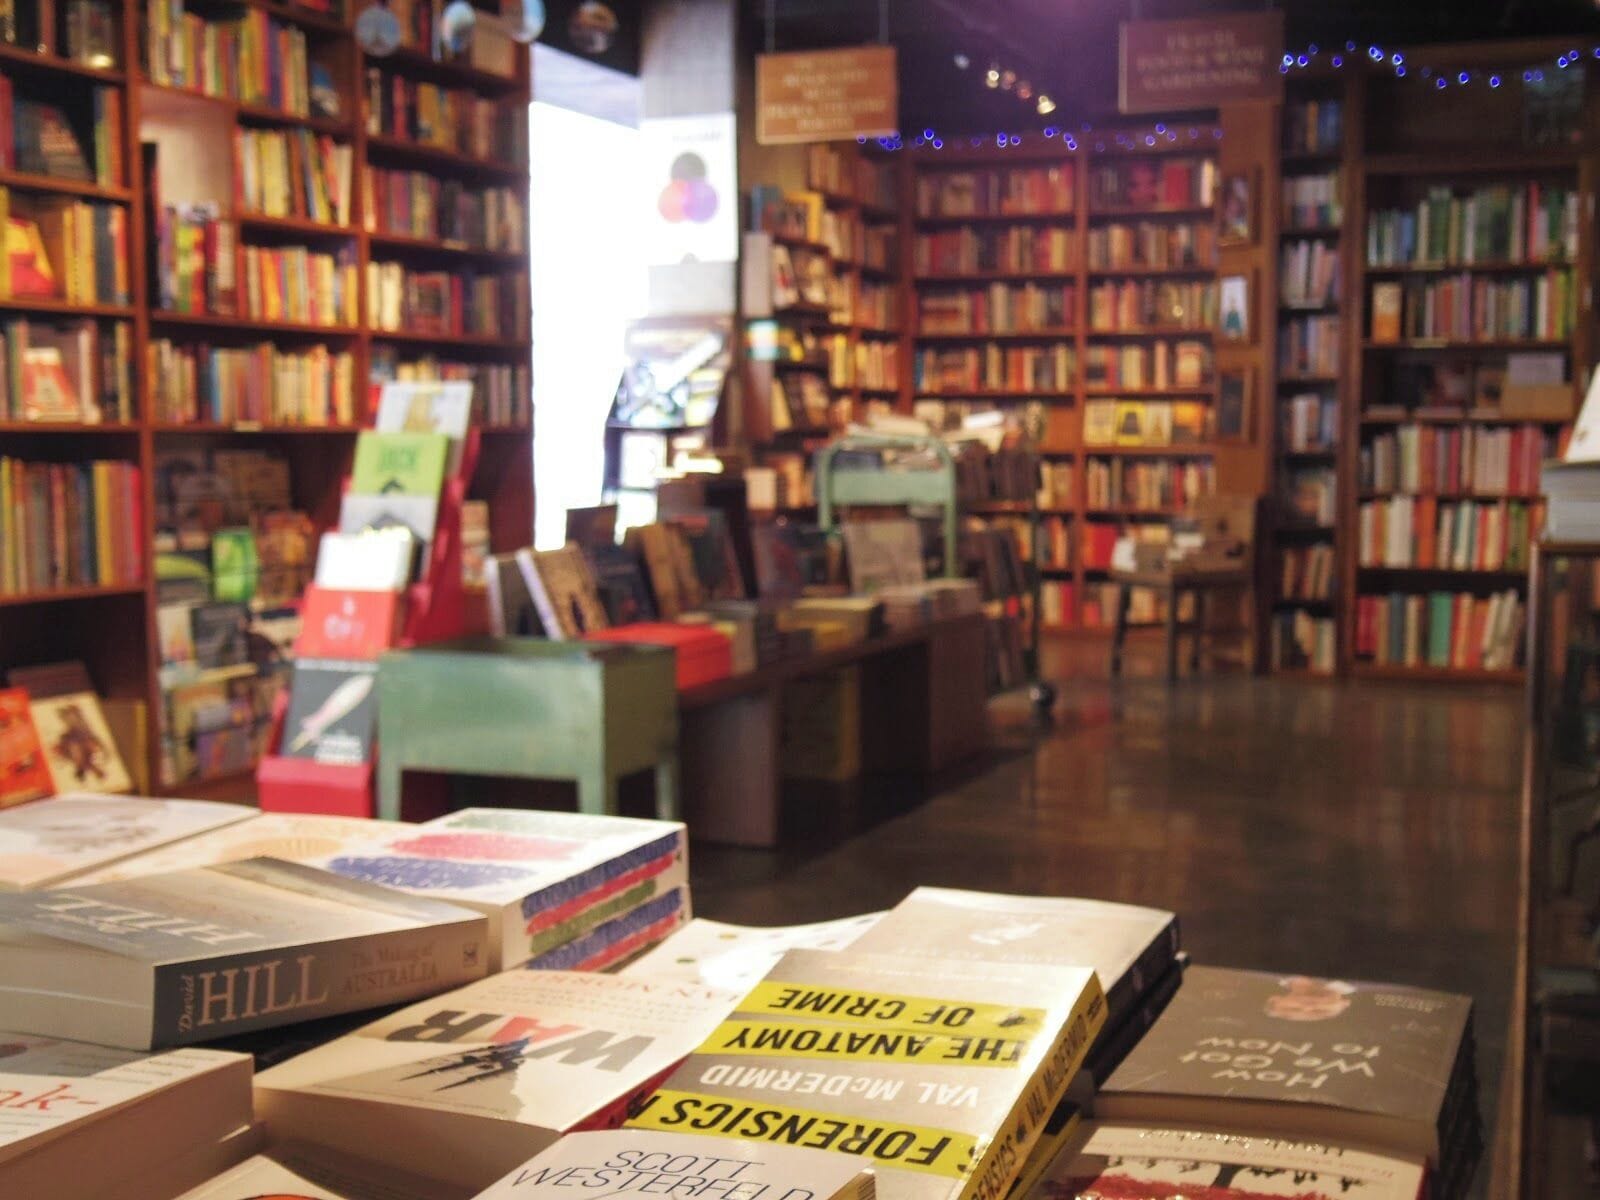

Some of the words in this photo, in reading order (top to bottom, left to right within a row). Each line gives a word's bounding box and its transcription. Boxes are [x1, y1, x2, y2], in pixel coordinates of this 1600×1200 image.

[197, 954, 330, 1027] HILL
[341, 960, 439, 993] AUSTRALIA
[178, 974, 195, 1034] David
[768, 988, 907, 1019] CRIME
[914, 1005, 976, 1029] OF
[386, 1009, 656, 1072] WAR
[723, 1026, 925, 1058] ANATOMY
[944, 1036, 1024, 1062] THE
[1194, 1035, 1314, 1056] Now
[1332, 1042, 1380, 1058] to
[1180, 1051, 1273, 1069] Got
[1294, 1054, 1375, 1077] We
[700, 1063, 905, 1102] McDERMID
[1211, 1067, 1329, 1090] How
[916, 1083, 981, 1109] VAL
[660, 1098, 953, 1166] FORENSICS
[604, 1150, 766, 1179] SCOTT
[512, 1167, 815, 1200] WESTERFELD
